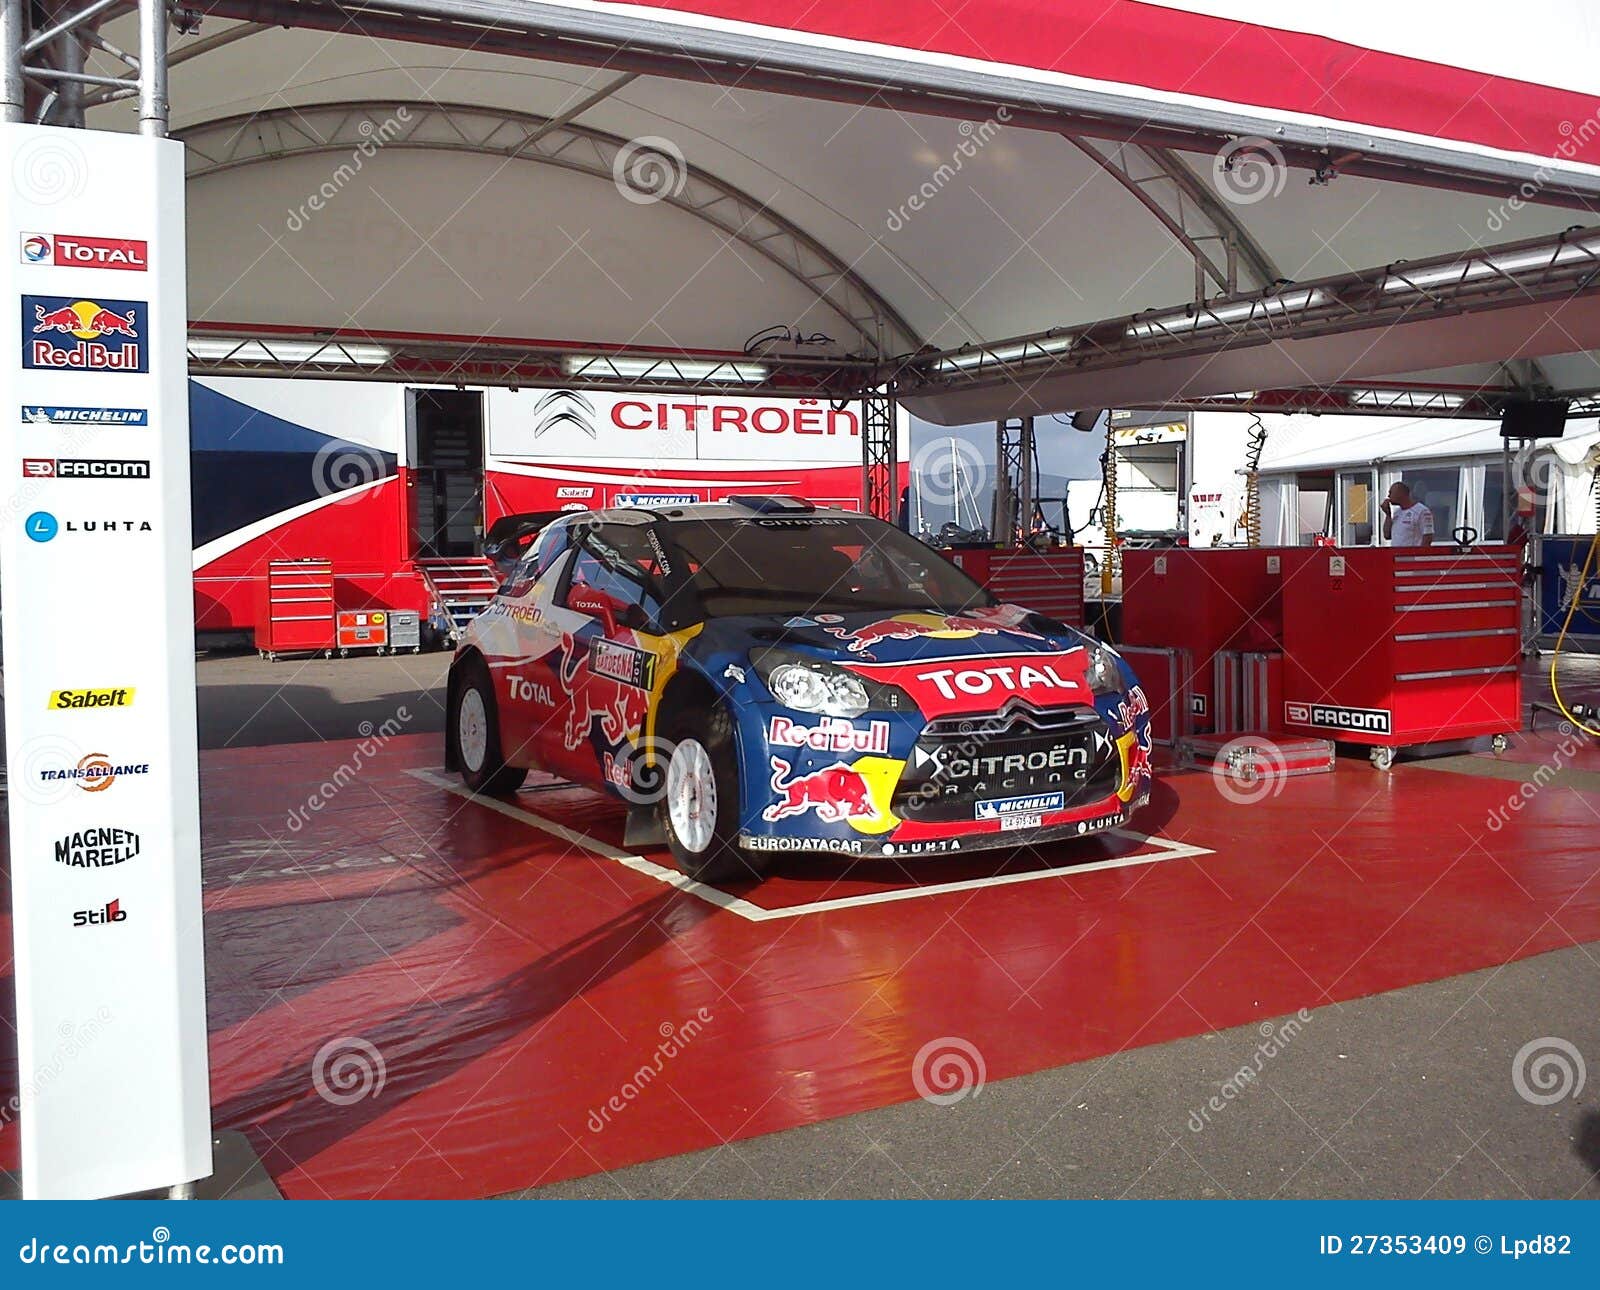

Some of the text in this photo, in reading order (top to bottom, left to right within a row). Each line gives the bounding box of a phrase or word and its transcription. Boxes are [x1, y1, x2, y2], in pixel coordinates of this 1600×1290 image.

[57, 241, 144, 265] TOTAL
[33, 340, 138, 369] Red Bull
[53, 410, 143, 423] MICHELIN
[60, 461, 148, 476] FACOM
[67, 521, 152, 532] LUHTA
[575, 600, 604, 609] TOTAL
[917, 665, 1078, 699] TOTAL
[57, 689, 127, 708] Sabelt
[506, 675, 555, 707] TOTAL
[1314, 709, 1386, 730] FACOM
[770, 716, 889, 753] Red Bull
[41, 764, 149, 781] TRANSALLIANCE
[999, 794, 1060, 812] MICHELIN
[1089, 813, 1124, 830] LUHTA
[750, 838, 861, 853] EURODATACAR
[899, 839, 960, 854] LUHTA
